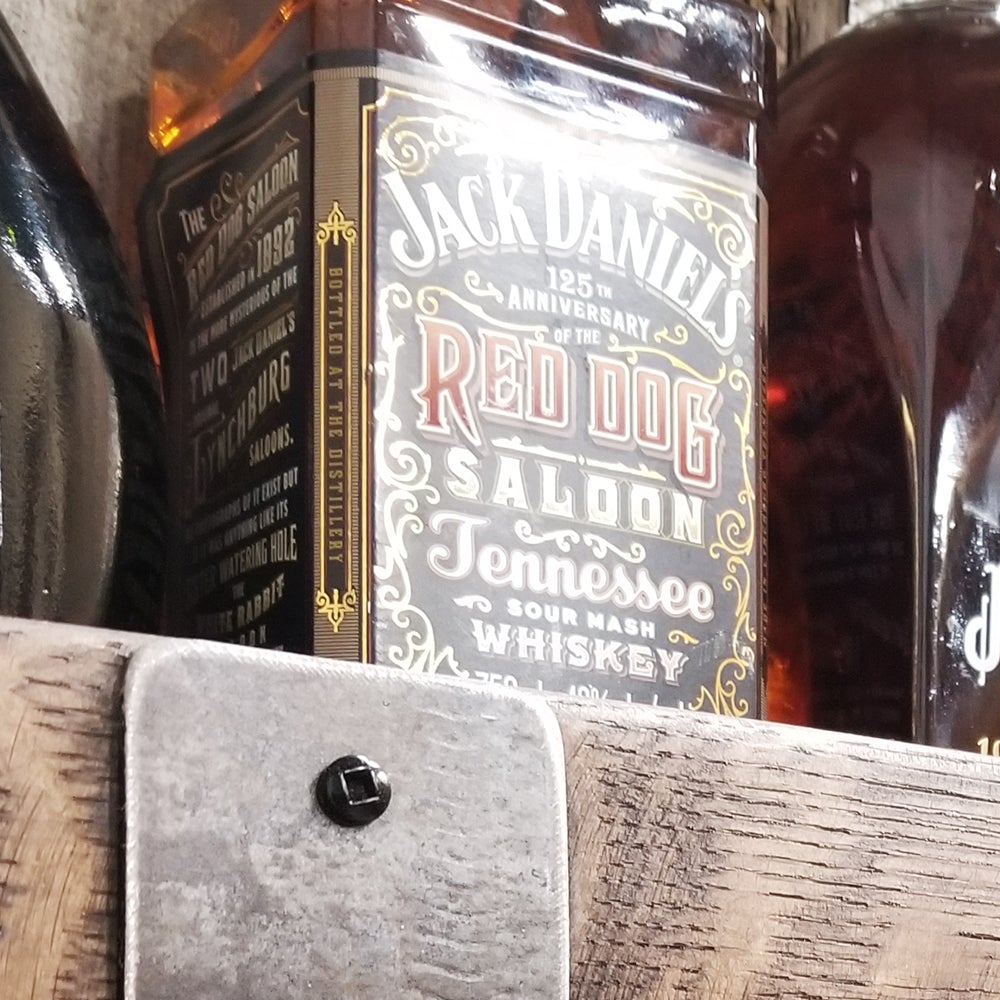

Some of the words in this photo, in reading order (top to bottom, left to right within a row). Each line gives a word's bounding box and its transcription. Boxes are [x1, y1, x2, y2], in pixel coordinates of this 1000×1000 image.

[246, 148, 299, 227] SALOON
[383, 158, 540, 274] JACK
[179, 206, 208, 243] THE
[256, 215, 296, 280] 1892
[282, 265, 299, 291] THE
[328, 267, 344, 355] BOTTLED
[507, 283, 651, 343] ANNIVERSARY
[553, 328, 572, 345] OF
[575, 328, 601, 345] THE
[189, 350, 229, 405] TWO
[328, 366, 344, 391] AT
[411, 314, 574, 448] RED
[587, 353, 723, 494] DOG
[328, 400, 344, 439] THE
[258, 505, 276, 531] LIKE
[275, 498, 290, 522] ITS
[261, 474, 282, 503] EXIST
[282, 465, 299, 492] BUT
[327, 449, 344, 564] DISTILLERY
[444, 446, 707, 547] SALOON
[218, 536, 269, 585] WATERING
[269, 523, 299, 564] HOLE
[426, 510, 716, 623] Tennessee
[507, 598, 578, 627] SOUR
[588, 611, 657, 640] MASH
[471, 617, 690, 687] WHISKEY
